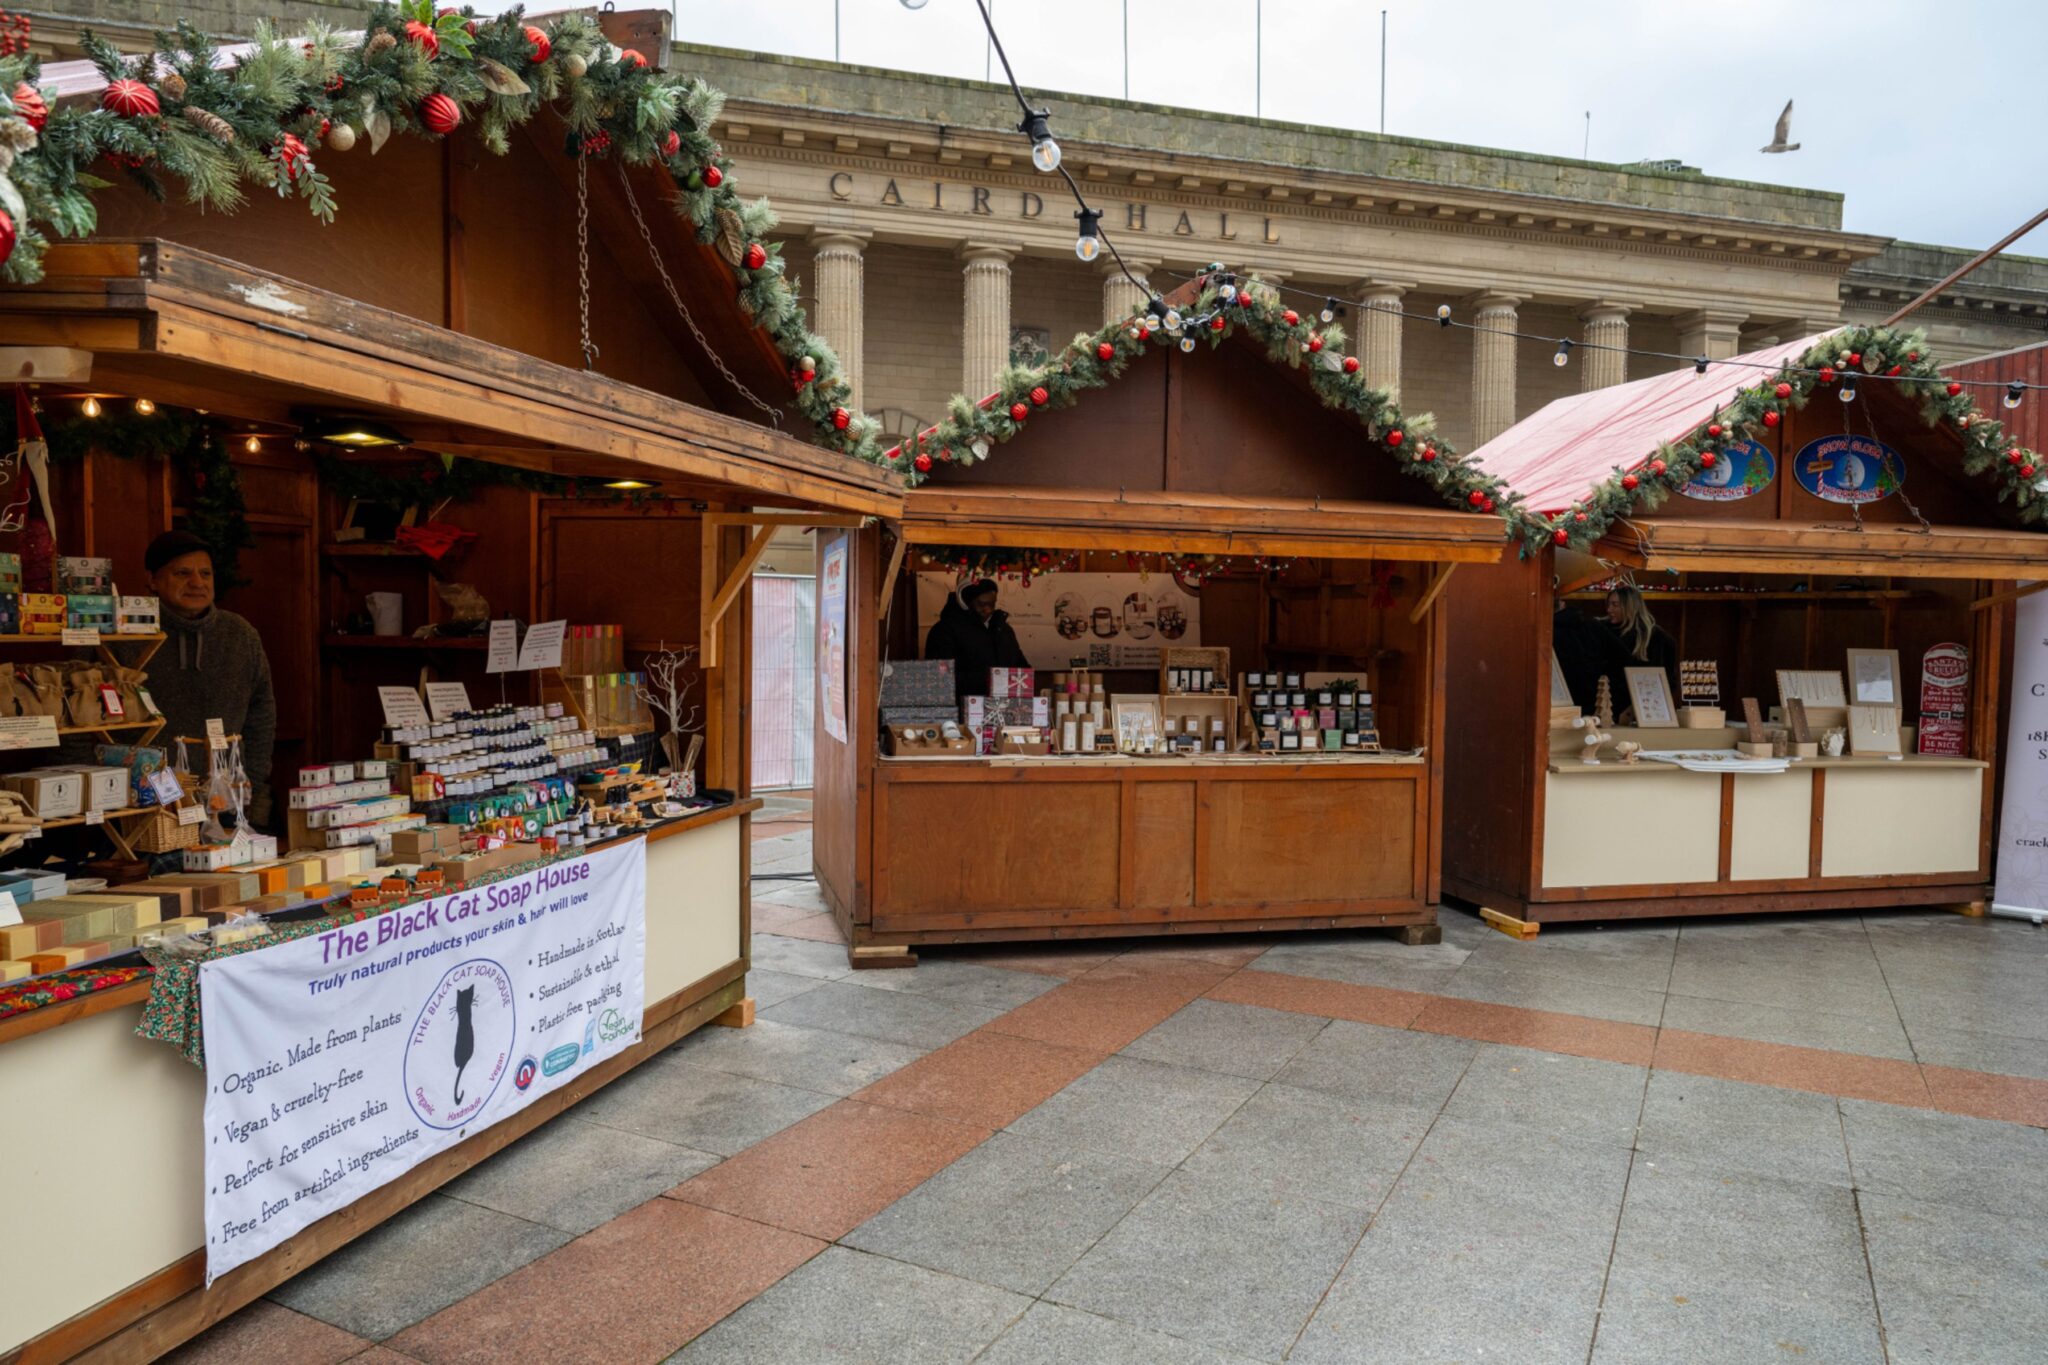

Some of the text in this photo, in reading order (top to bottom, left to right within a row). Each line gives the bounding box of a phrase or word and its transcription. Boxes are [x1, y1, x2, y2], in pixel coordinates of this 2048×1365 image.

[830, 172, 1279, 243] CAIRD HALL
[309, 892, 589, 996] Truly natural products your skin & hair will love
[318, 862, 590, 964] The Black Cat Soap House
[538, 938, 585, 968] Handmade
[596, 922, 626, 944] Scotla
[413, 965, 511, 1046] THE BLACK CAT SOAP HOUSE
[538, 968, 583, 1002] Sustainable
[584, 963, 593, 976] &
[566, 1001, 583, 1018] free
[223, 1014, 402, 1094] Organic. Made from plants
[489, 1052, 506, 1082] Vegan
[224, 1068, 364, 1143] Vegan & cruelty-free
[415, 1087, 435, 1116] Organic
[446, 1096, 482, 1121] Handmade
[224, 1099, 388, 1194] Perfect for sensitive skin
[222, 1128, 420, 1243] Free from artifical ingredients
